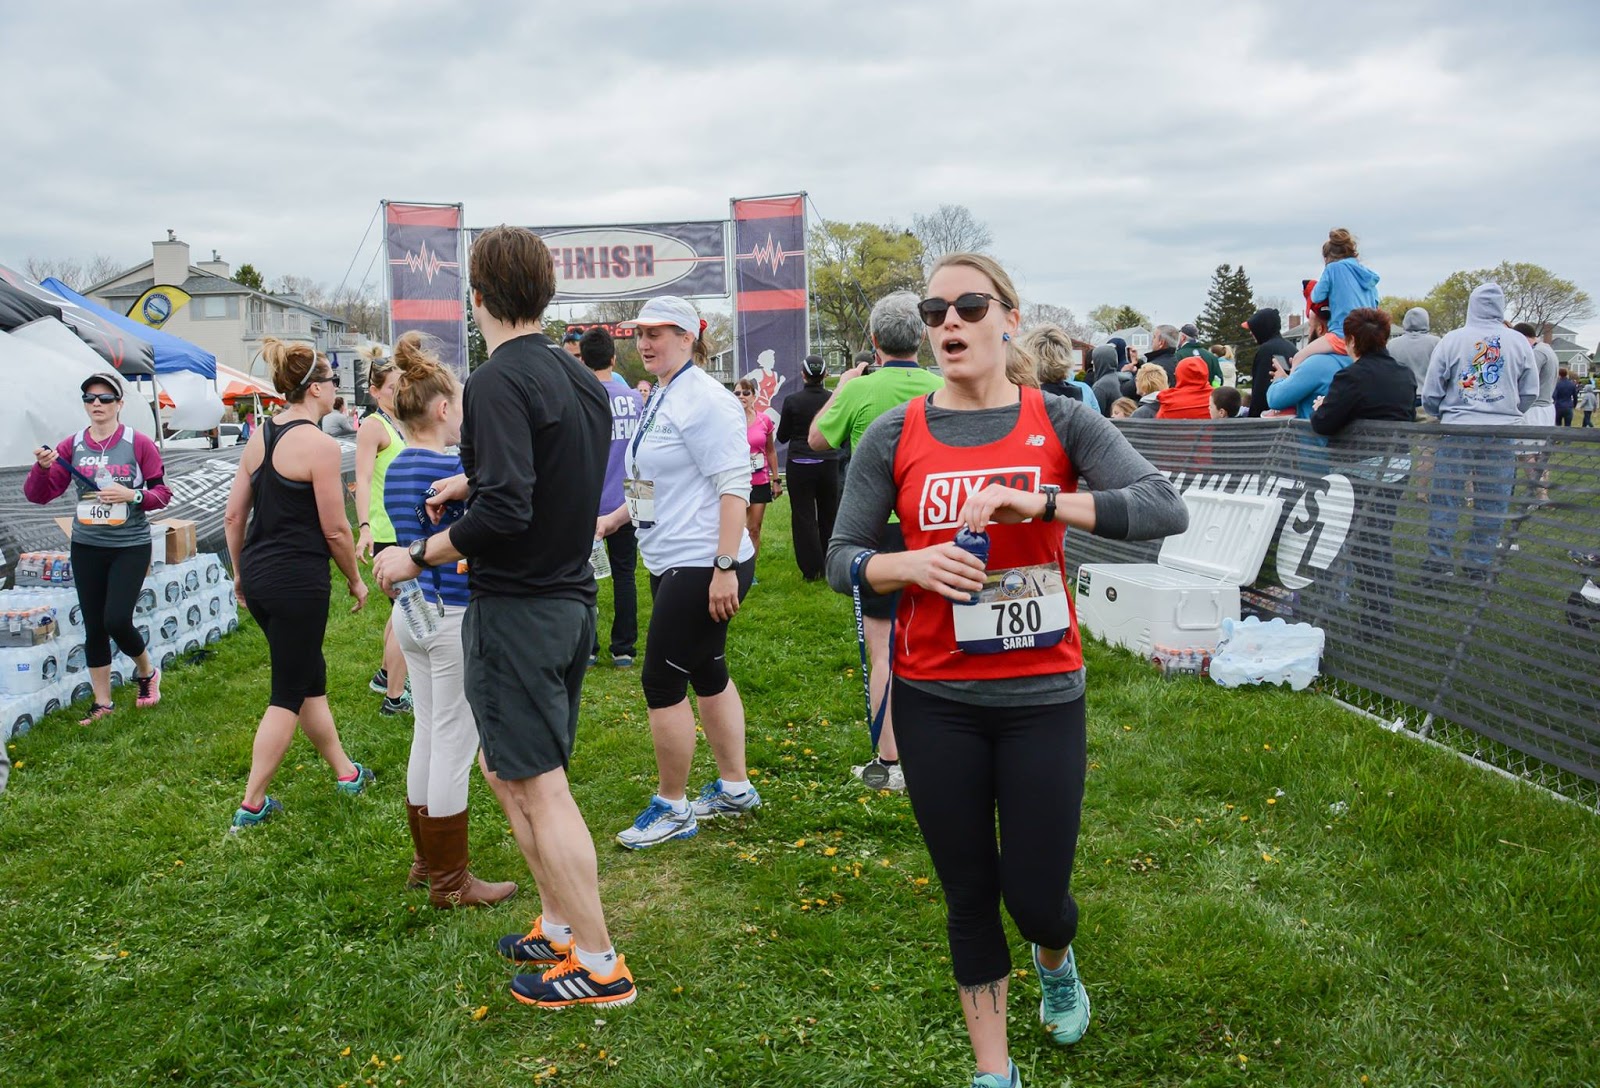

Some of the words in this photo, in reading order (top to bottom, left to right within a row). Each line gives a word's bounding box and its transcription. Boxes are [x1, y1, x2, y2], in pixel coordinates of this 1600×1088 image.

[79, 456, 109, 467] SOLE
[927, 474, 1029, 523] SIX
[90, 505, 111, 518] 466
[853, 584, 865, 643] FINISHER
[991, 600, 1042, 636] 780
[1003, 635, 1035, 650] SARAH
